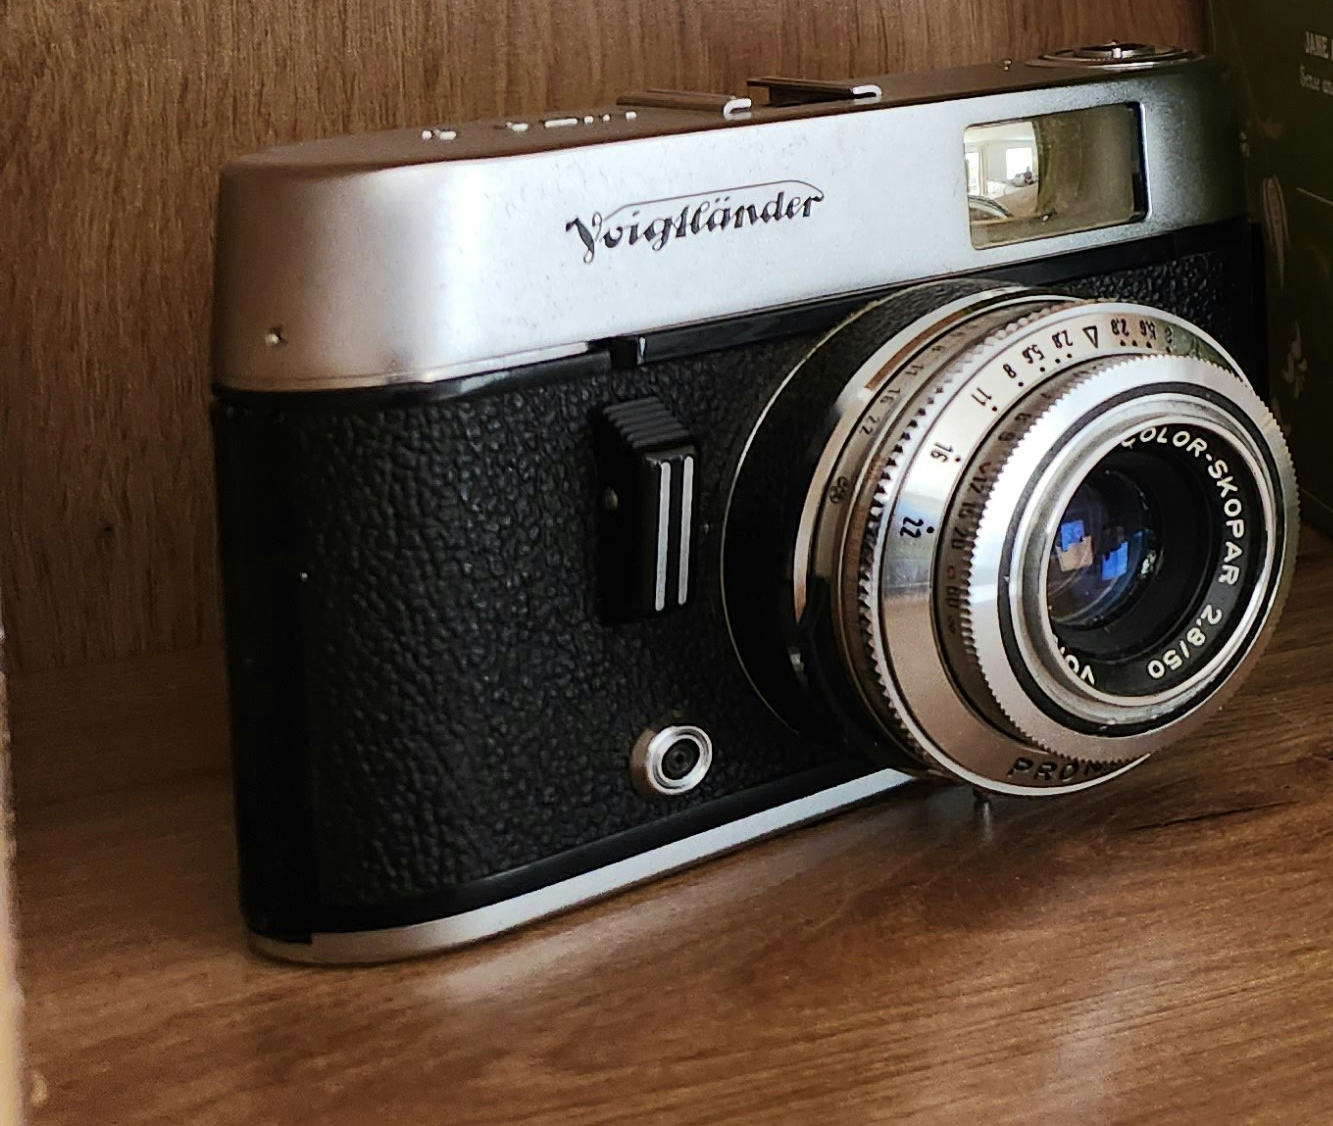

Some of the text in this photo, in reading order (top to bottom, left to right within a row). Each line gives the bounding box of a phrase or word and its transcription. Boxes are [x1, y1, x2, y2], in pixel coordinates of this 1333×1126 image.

[1305, 31, 1330, 59] JANE
[566, 180, 825, 264] Voigtländer
[899, 516, 925, 539] 22
[930, 441, 954, 464] 16
